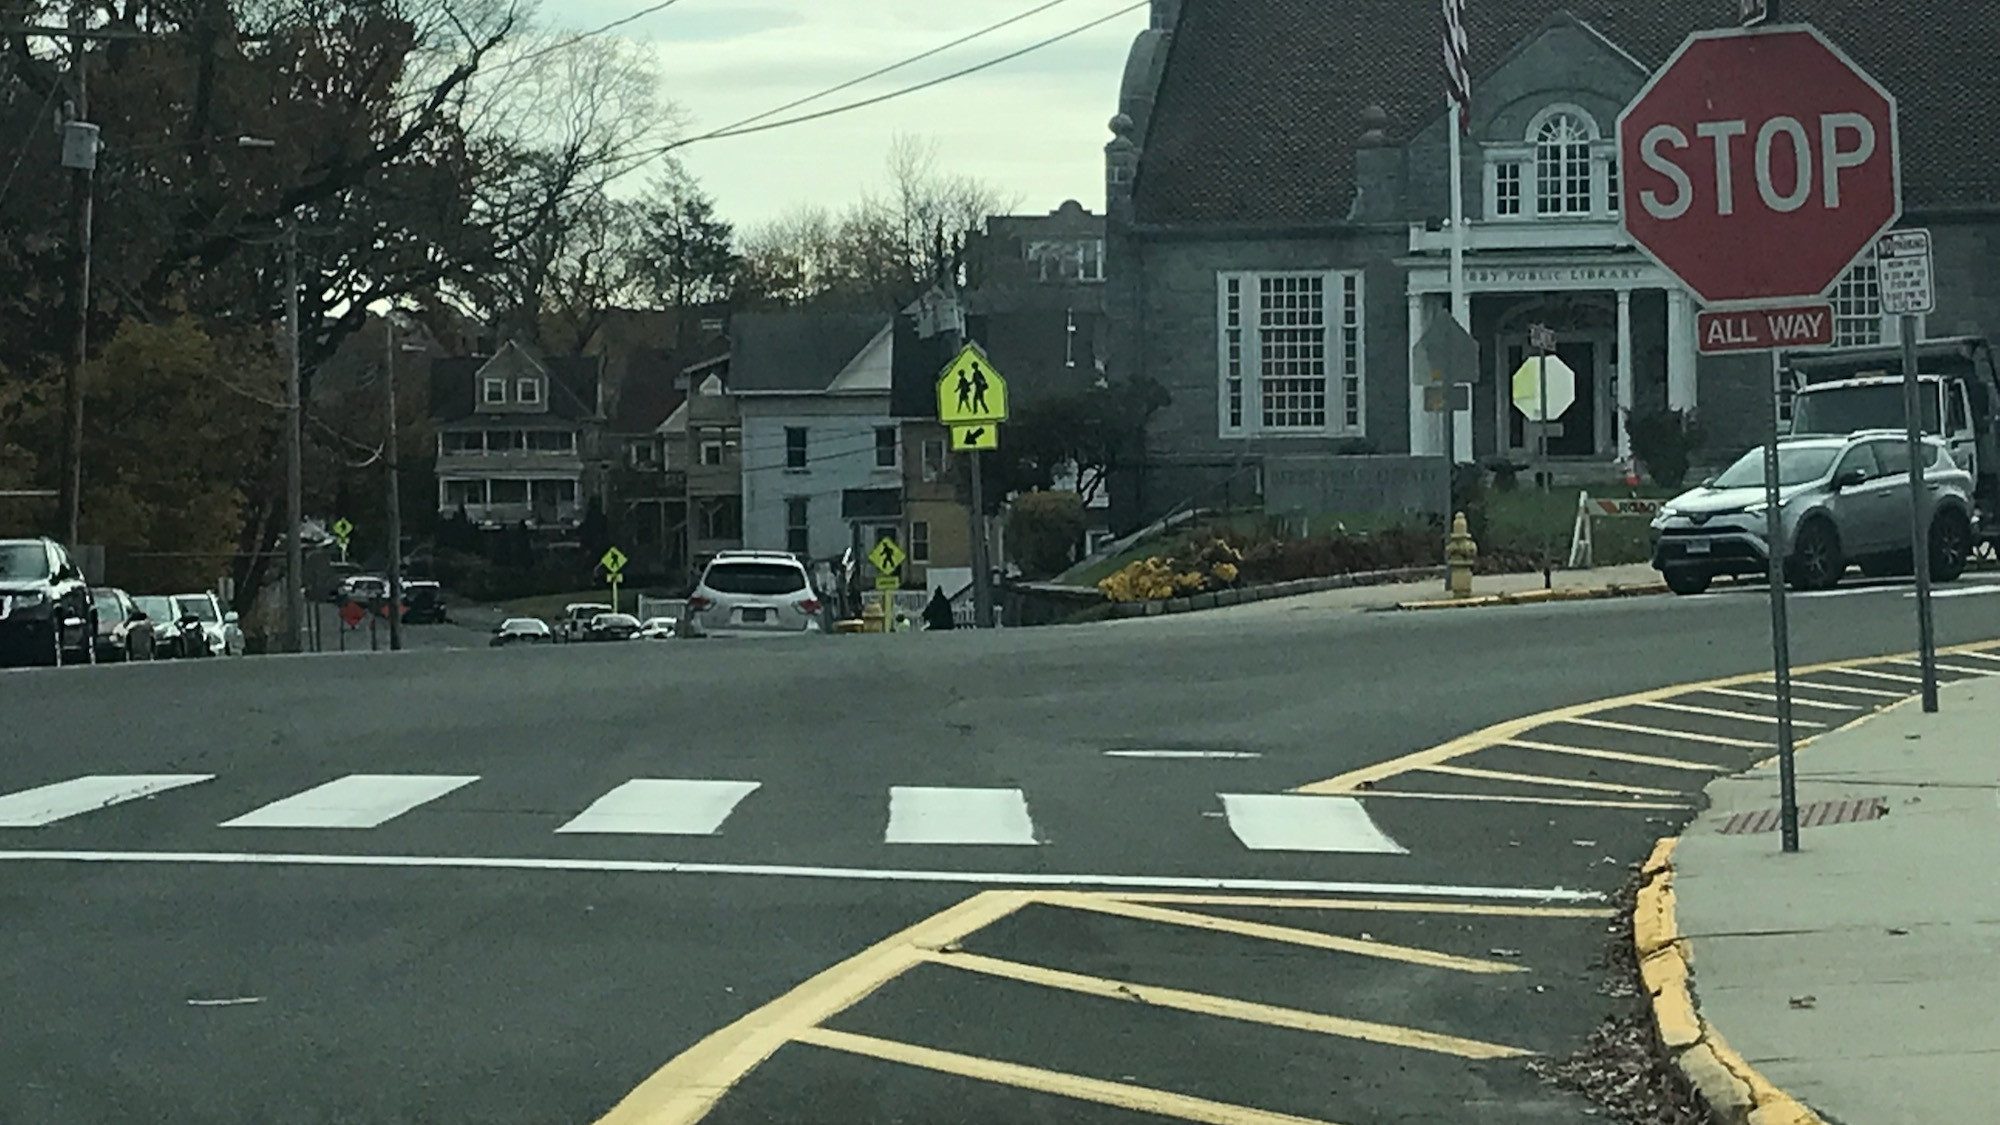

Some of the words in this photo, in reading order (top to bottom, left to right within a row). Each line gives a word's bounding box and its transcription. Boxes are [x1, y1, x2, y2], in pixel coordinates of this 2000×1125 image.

[1639, 112, 1876, 220] STOP
[1507, 269, 1562, 282] PUBLIC
[1570, 268, 1642, 281] LIBRARY
[1707, 318, 1757, 344] ALL
[1768, 312, 1824, 340] WAY
